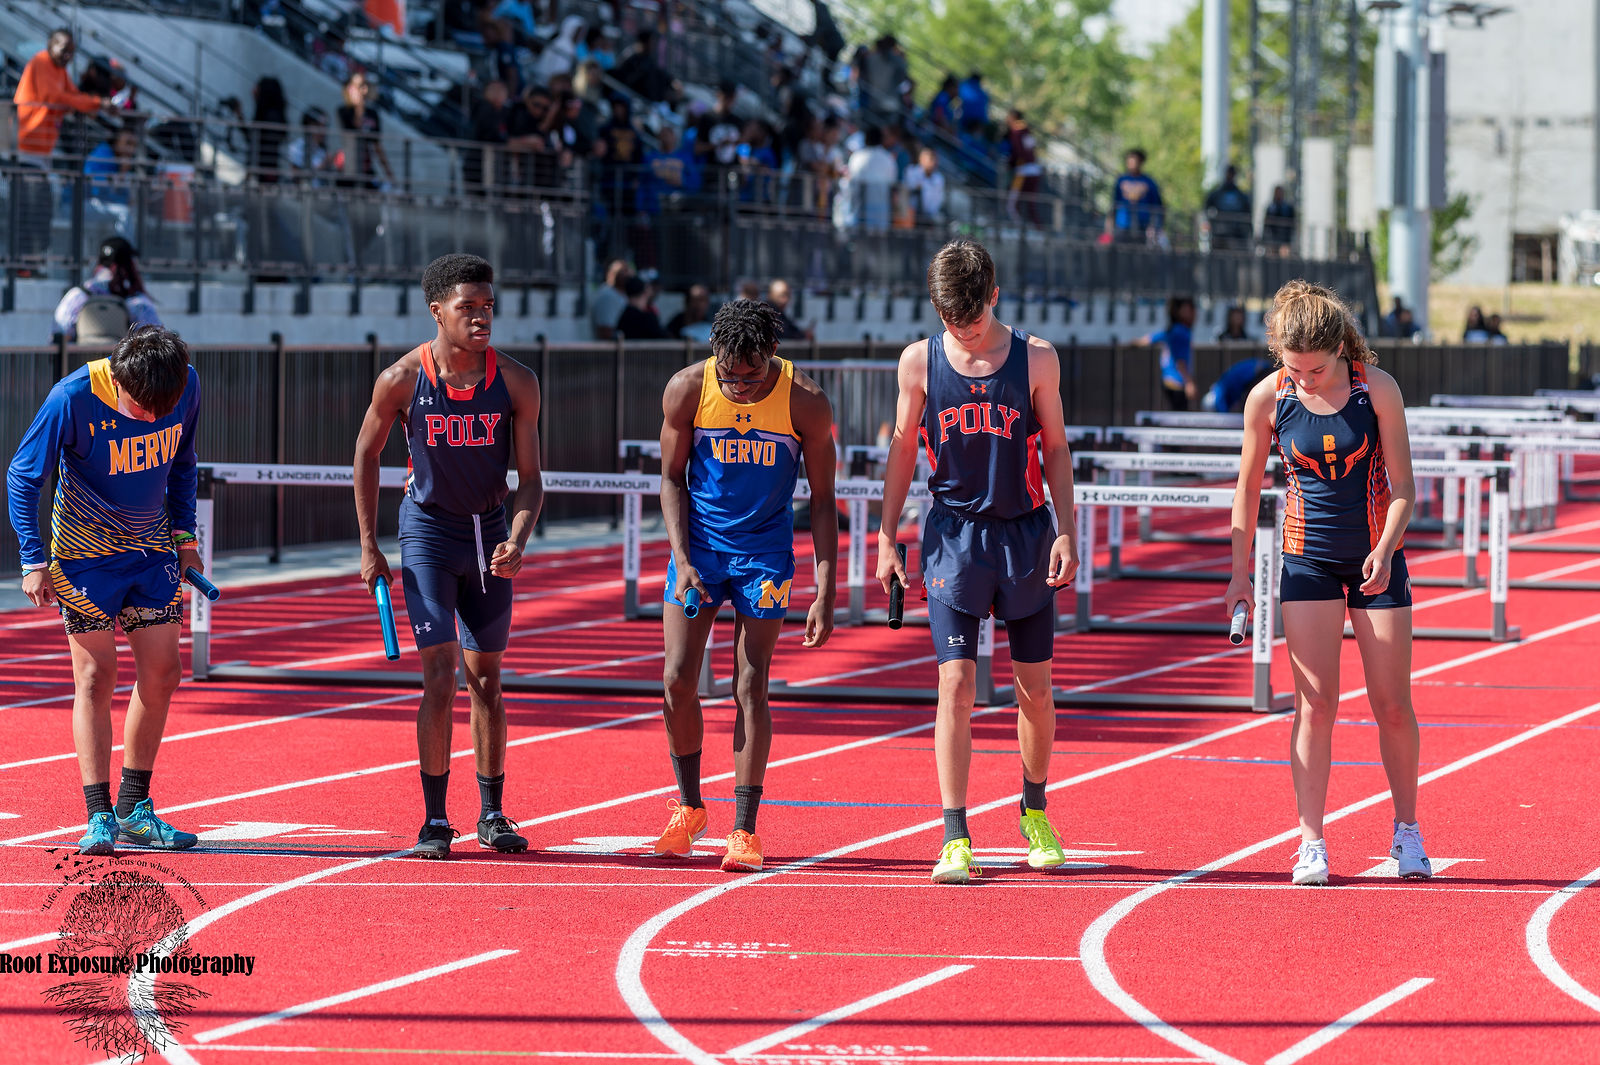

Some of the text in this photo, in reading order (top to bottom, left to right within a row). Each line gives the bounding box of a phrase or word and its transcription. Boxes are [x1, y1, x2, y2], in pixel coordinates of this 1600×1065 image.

[424, 412, 502, 447] POLY
[937, 402, 1021, 444] POLY
[108, 423, 183, 476] MERVO
[711, 437, 777, 467] MERVO
[276, 471, 354, 481] UNDER ARM
[545, 478, 651, 489] UNDER ARMOUR
[1102, 493, 1210, 504] UNDER ARMOUR
[758, 579, 793, 609] M
[1260, 553, 1269, 653] UNDER ARMOUR
